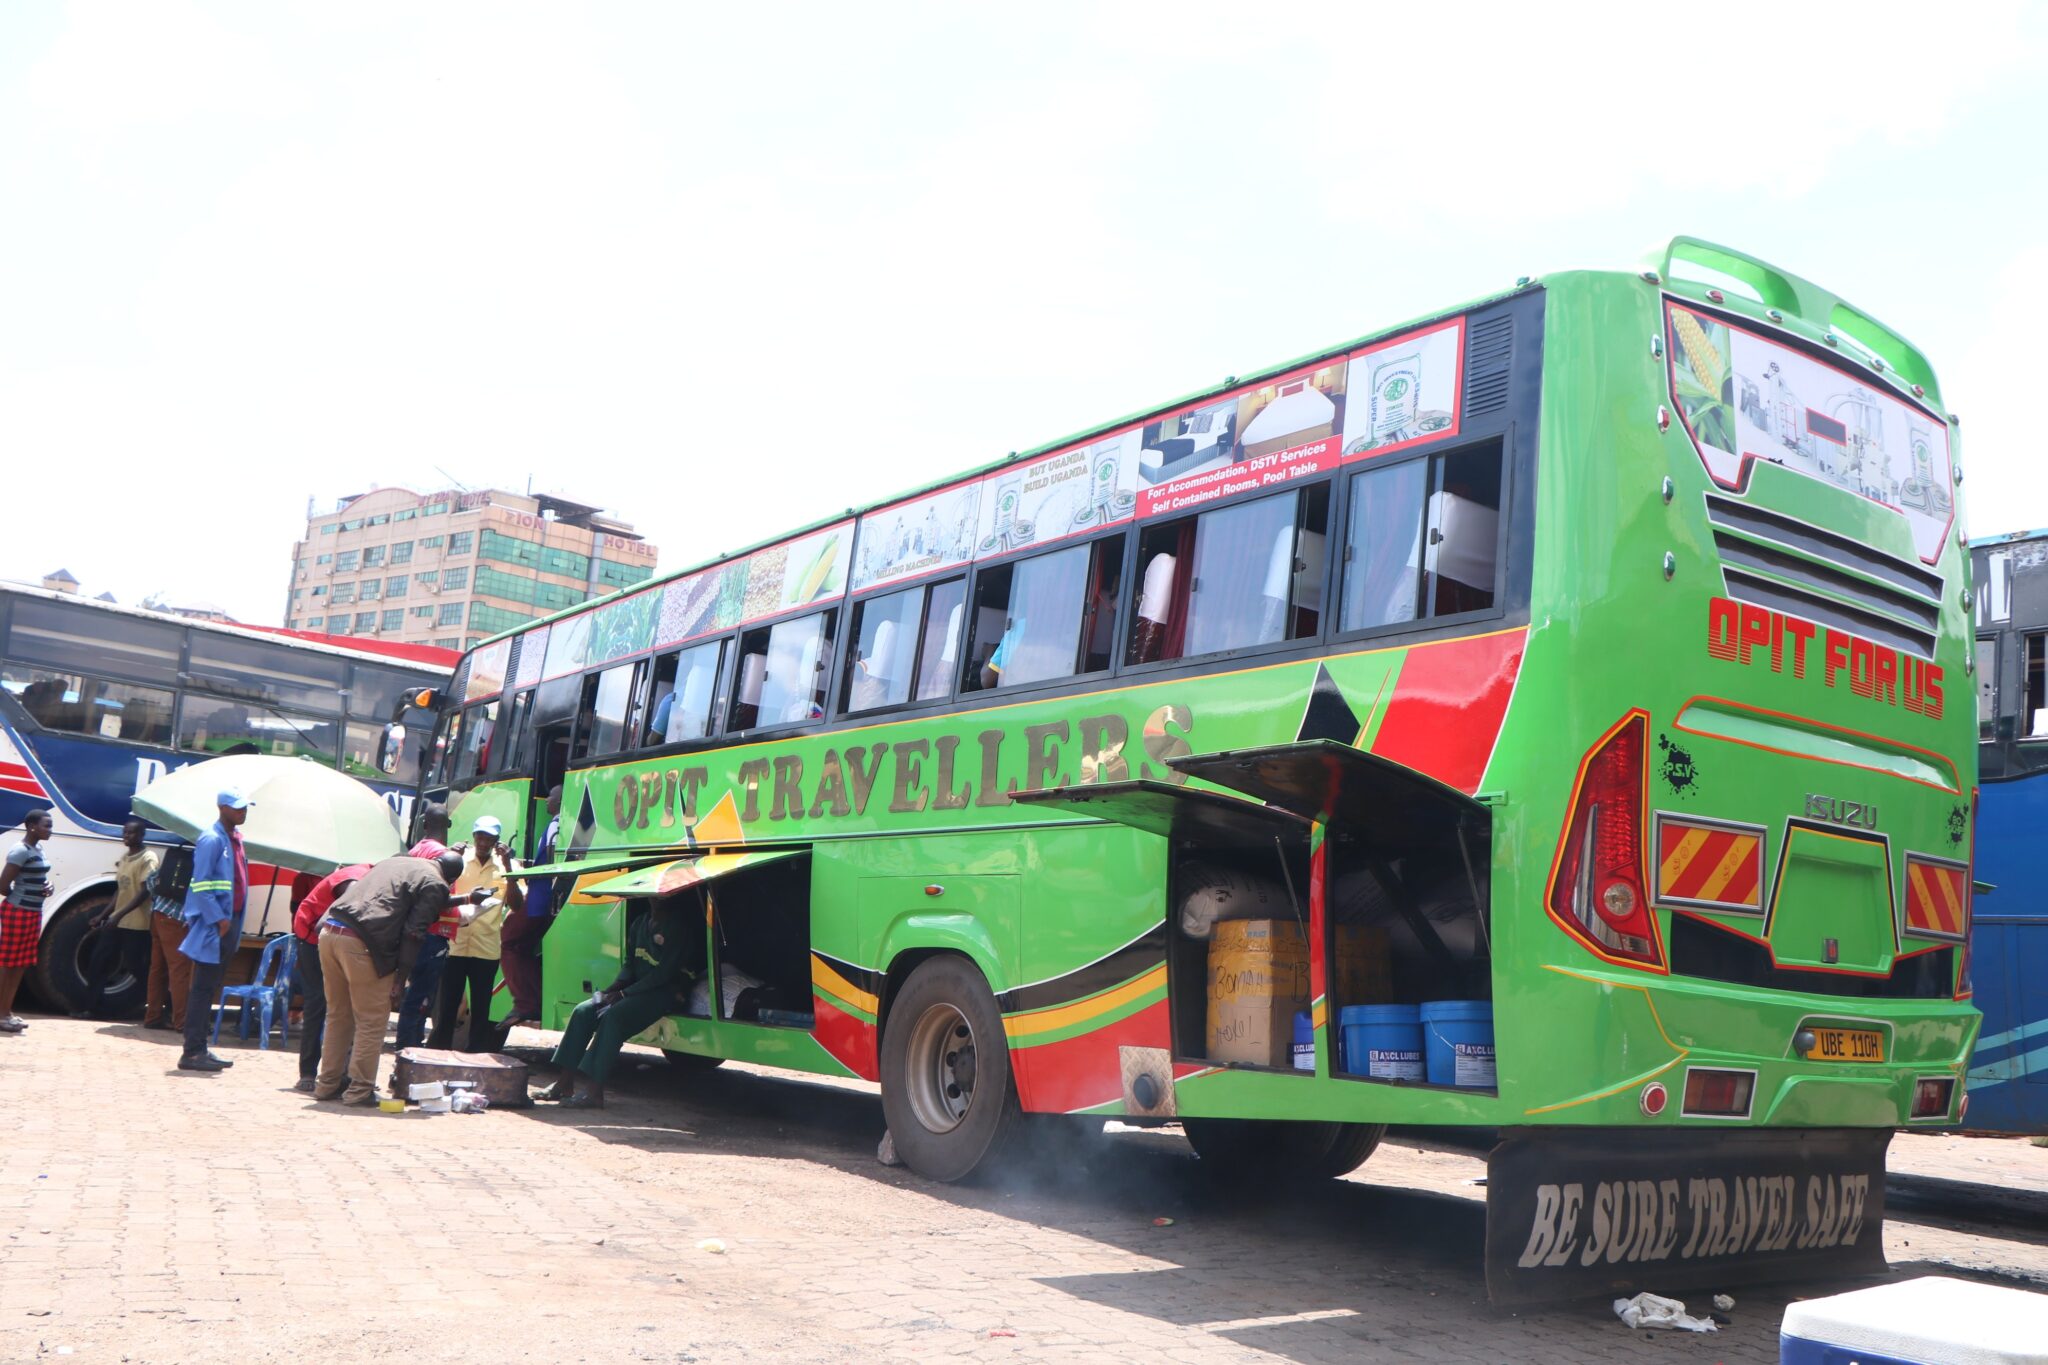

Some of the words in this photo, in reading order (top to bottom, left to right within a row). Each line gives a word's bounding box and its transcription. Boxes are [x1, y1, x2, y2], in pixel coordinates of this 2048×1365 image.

[1024, 477, 1049, 493] BUILD
[1050, 464, 1088, 485] UGANDA
[1029, 463, 1046, 478] BUY
[1049, 451, 1086, 472] UGANDA
[1148, 488, 1165, 501] For:
[1168, 465, 1248, 493] Accommodation,
[1250, 455, 1278, 472] DSTV
[1280, 443, 1327, 463] Services
[1152, 500, 1170, 514] Self
[1172, 485, 1220, 508] Contained
[1223, 479, 1260, 498] Rooms,
[1263, 471, 1286, 484] Pool
[1289, 462, 1318, 477] Table
[604, 535, 655, 557] HOTEL
[1708, 596, 1816, 679] OPIT
[1825, 628, 1897, 706] FOR
[1903, 655, 1944, 720] US
[614, 766, 709, 831] OPIT
[738, 704, 1193, 822] TRAVELLERS
[1805, 792, 1877, 830] ISUZU
[1821, 1032, 1845, 1056] UBE
[1851, 1034, 1879, 1058] 110H
[1518, 1184, 1583, 1268] BE
[1580, 1179, 1680, 1267] SURE
[1682, 1175, 1799, 1258] TRAVEL
[1797, 1173, 1869, 1249] SAFE
